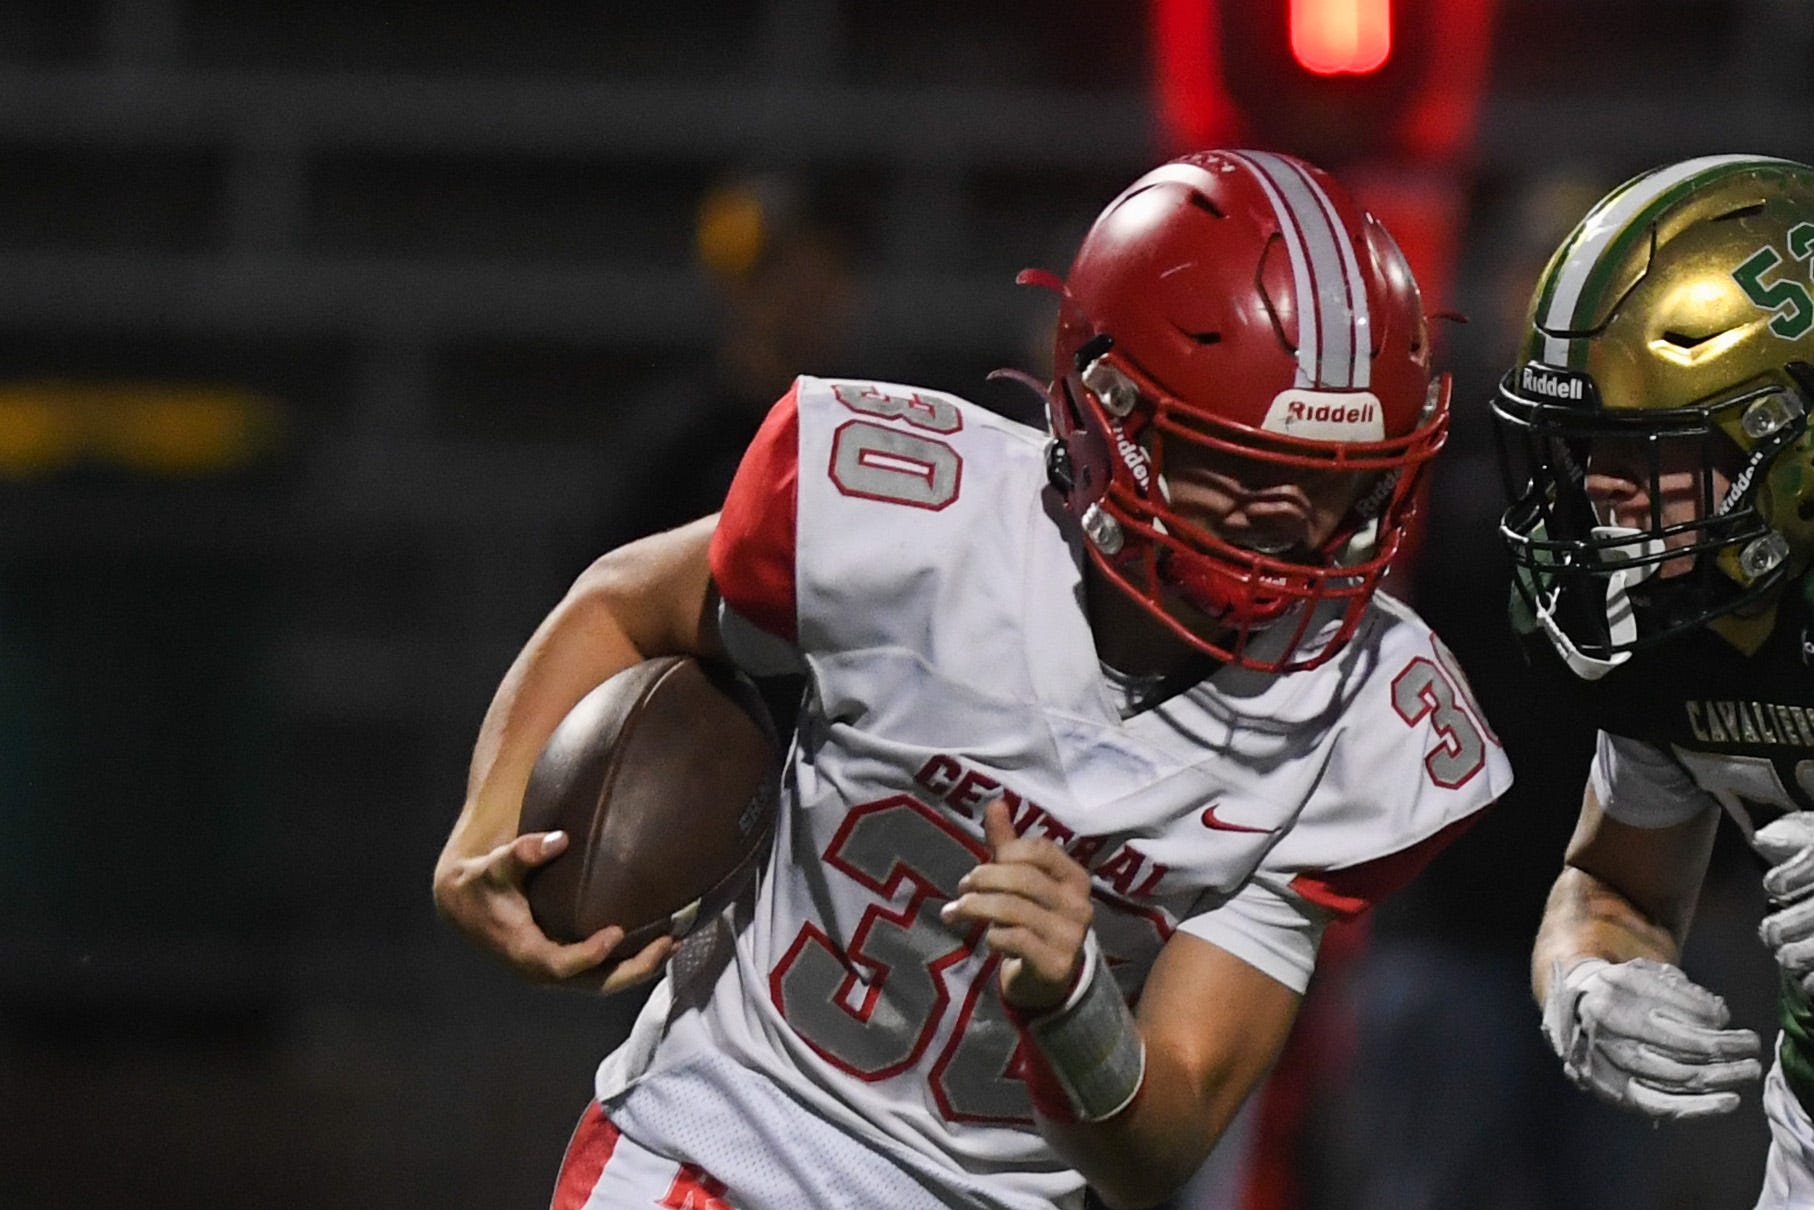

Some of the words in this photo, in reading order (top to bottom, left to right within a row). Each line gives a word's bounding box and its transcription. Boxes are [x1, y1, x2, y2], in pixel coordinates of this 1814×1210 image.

[1284, 401, 1374, 425] Riddell
[1522, 367, 1583, 400] Riddell
[828, 384, 963, 512] 30
[915, 754, 1168, 897] CENTRAL
